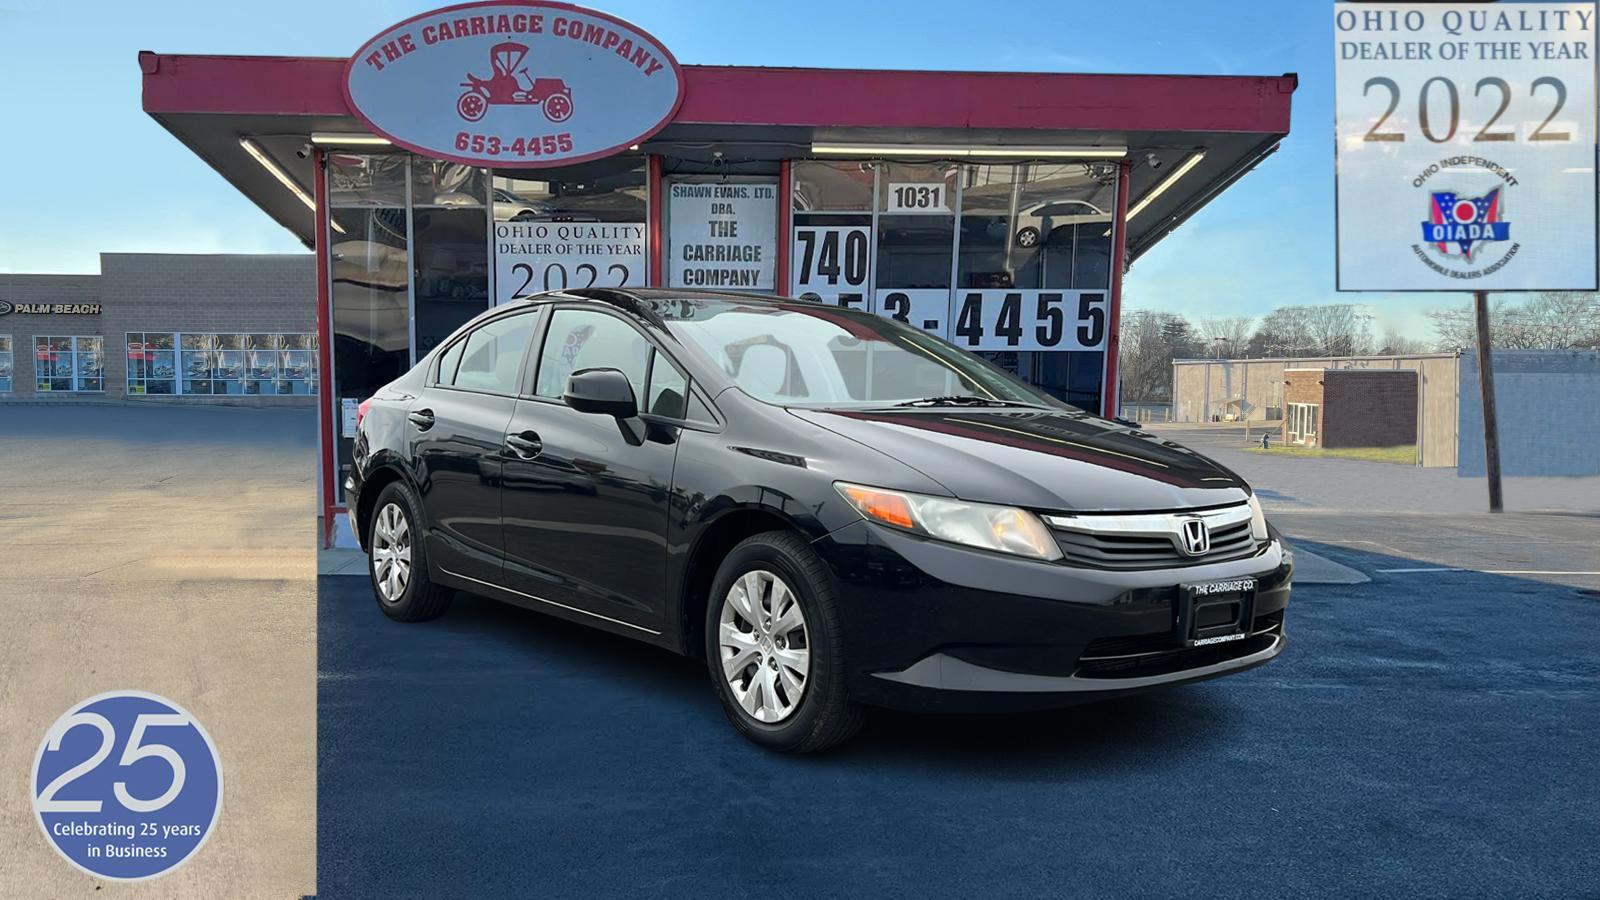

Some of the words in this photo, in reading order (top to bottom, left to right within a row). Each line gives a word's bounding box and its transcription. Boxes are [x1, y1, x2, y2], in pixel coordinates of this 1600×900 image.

[1336, 10, 1426, 31] OHIO
[1441, 10, 1593, 36] QUALITY
[366, 34, 416, 71] THE
[422, 14, 544, 46] CARRIAGE
[552, 17, 664, 77] COMPANY
[1340, 41, 1433, 60] DEALER
[1439, 41, 1470, 60] OF
[1475, 41, 1522, 60] THE
[1527, 41, 1589, 60] YEAR
[1363, 76, 1571, 143] 2022
[455, 132, 573, 156] 653-4455
[1412, 163, 1440, 188] OHIO
[1440, 155, 1519, 187] INDEPENDENT
[672, 186, 712, 198] SHAWN
[754, 187, 775, 200] LTD.
[894, 186, 941, 208] 1031
[711, 203, 736, 215] DBA.
[497, 226, 548, 238] OHIO
[557, 226, 644, 241] QUALITY
[708, 220, 738, 238] THE
[1432, 225, 1495, 240] OIADA
[499, 243, 551, 255] DEALER
[555, 244, 574, 255] OF
[576, 244, 603, 255] THE
[606, 244, 641, 255] YEAR
[683, 244, 762, 262] CARRIAGE
[797, 230, 868, 286] 740
[683, 268, 761, 286] COMPANY
[1450, 269, 1482, 280] DEALERS
[15, 303, 51, 314] PALM
[1195, 584, 1209, 595] THE
[1209, 580, 1242, 593] CARRIAGE
